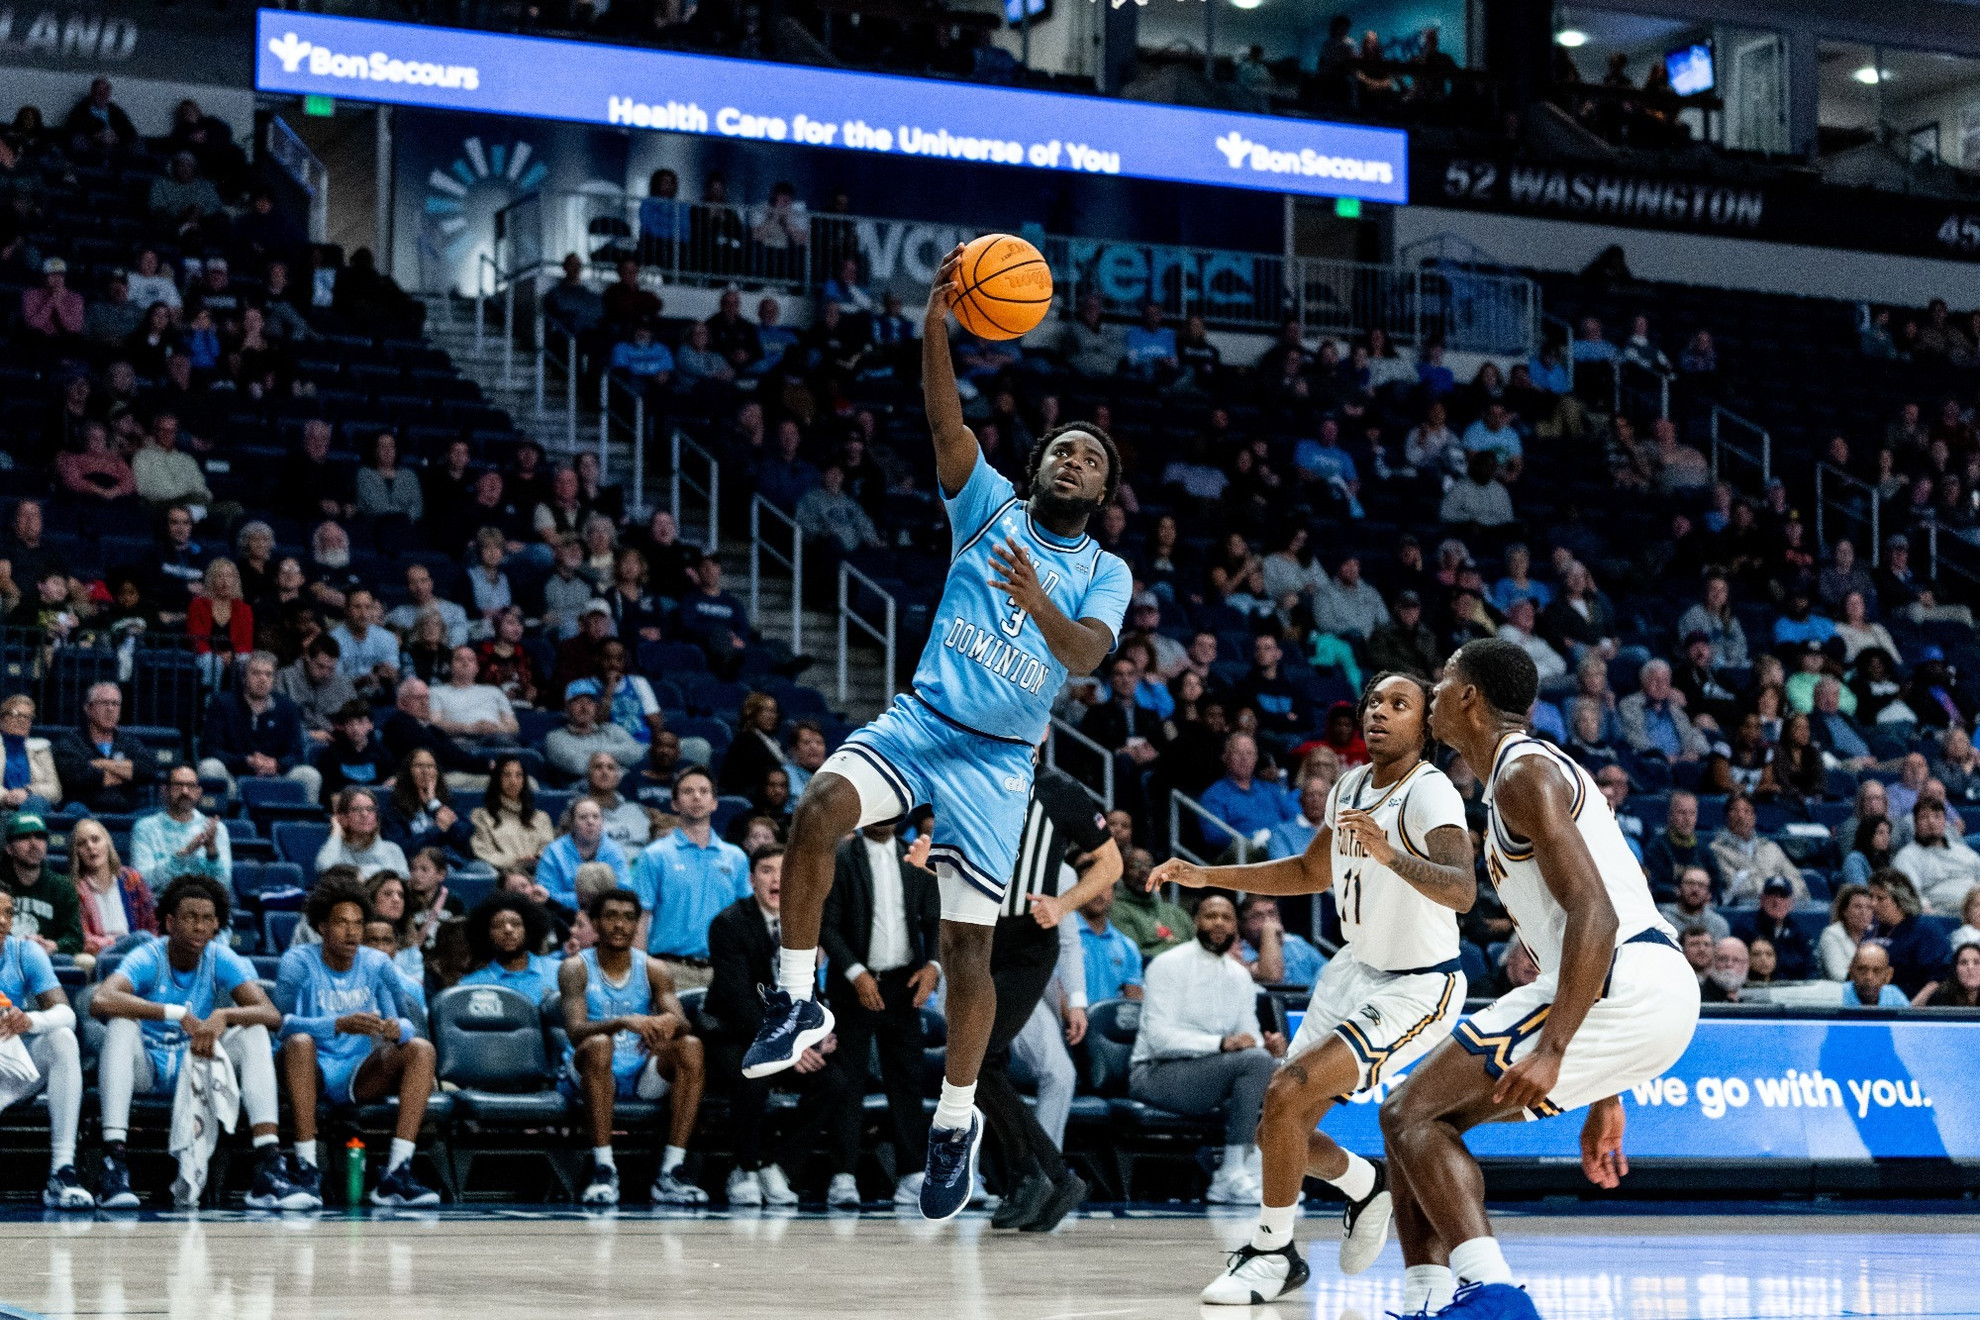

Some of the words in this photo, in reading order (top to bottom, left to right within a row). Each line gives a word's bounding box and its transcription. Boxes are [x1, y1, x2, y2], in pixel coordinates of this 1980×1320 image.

[608, 95, 709, 133] Health
[715, 106, 788, 140] Care
[793, 114, 838, 145] for
[843, 120, 893, 152] the
[898, 125, 1024, 165] Universe
[1028, 139, 1062, 168] of
[1065, 142, 1121, 174] You
[1445, 160, 1497, 199] 52
[1508, 164, 1764, 227] WASHINGTON
[1000, 594, 1030, 639] 3
[943, 615, 1051, 697] DOMINION
[1340, 867, 1362, 926] 11
[1631, 1076, 1688, 1107] we
[1696, 1077, 1750, 1119] go
[1754, 1068, 1844, 1107] with
[1847, 1078, 1933, 1119] you.
